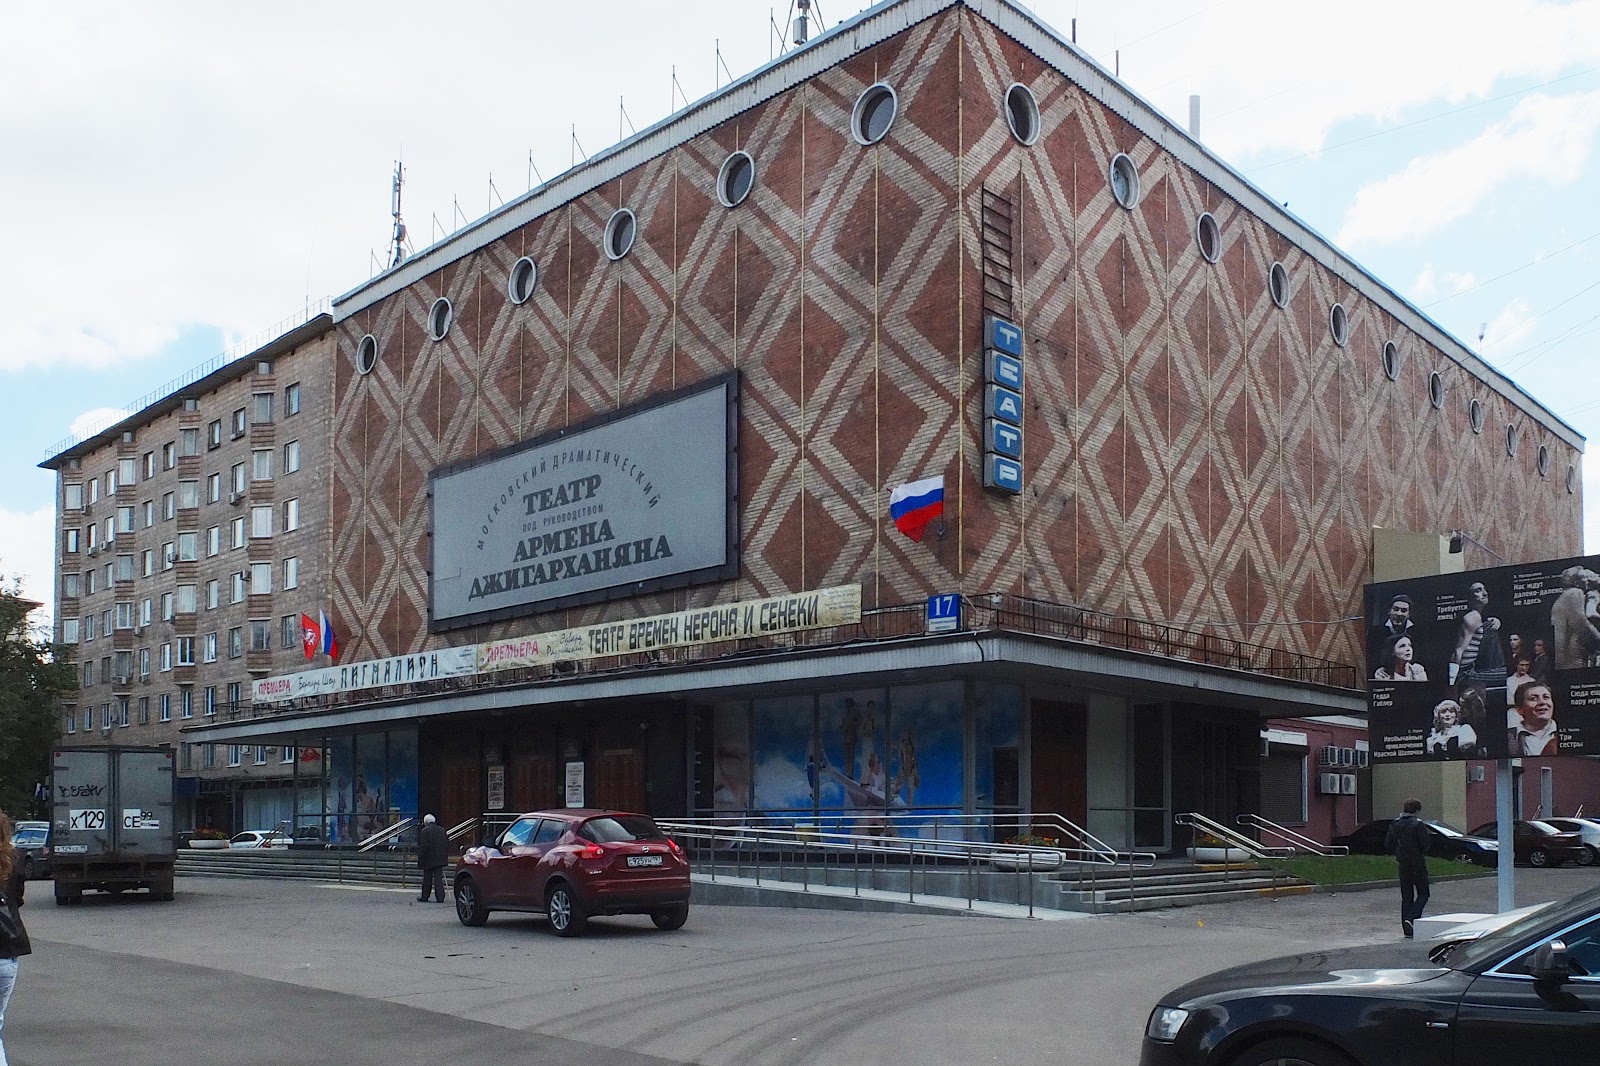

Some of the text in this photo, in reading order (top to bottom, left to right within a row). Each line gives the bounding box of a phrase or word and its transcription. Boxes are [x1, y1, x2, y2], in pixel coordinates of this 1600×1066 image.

[999, 326, 1018, 482] ТЕАТР
[477, 449, 661, 551] МОСКОВСКИЙ ДРАМАТИЧЕСКИЙ
[522, 474, 602, 516] ТЕАТР
[522, 503, 604, 533] ПОД РУКОВОДСТВОМ
[513, 518, 616, 563] АРМЕНА
[468, 534, 673, 602] ДЖИГАРХАНЯНА
[1513, 583, 1525, 591] Нас
[934, 595, 953, 616] 17
[588, 625, 624, 655] ТЕАТР
[629, 616, 678, 650] ВРЕМЕН
[684, 607, 739, 642] НЕРОНА
[743, 605, 754, 635] И
[760, 594, 819, 632] СЕНЕКИ
[487, 640, 539, 663] ПРЕМЬЕРА
[340, 653, 438, 689] ПИГМАЛИОН
[258, 679, 291, 695] ПРЕМЬЕРА
[1570, 698, 1587, 706] пару
[1559, 734, 1573, 742] Три
[1559, 741, 1584, 749] сестры
[140, 811, 153, 821] 99
